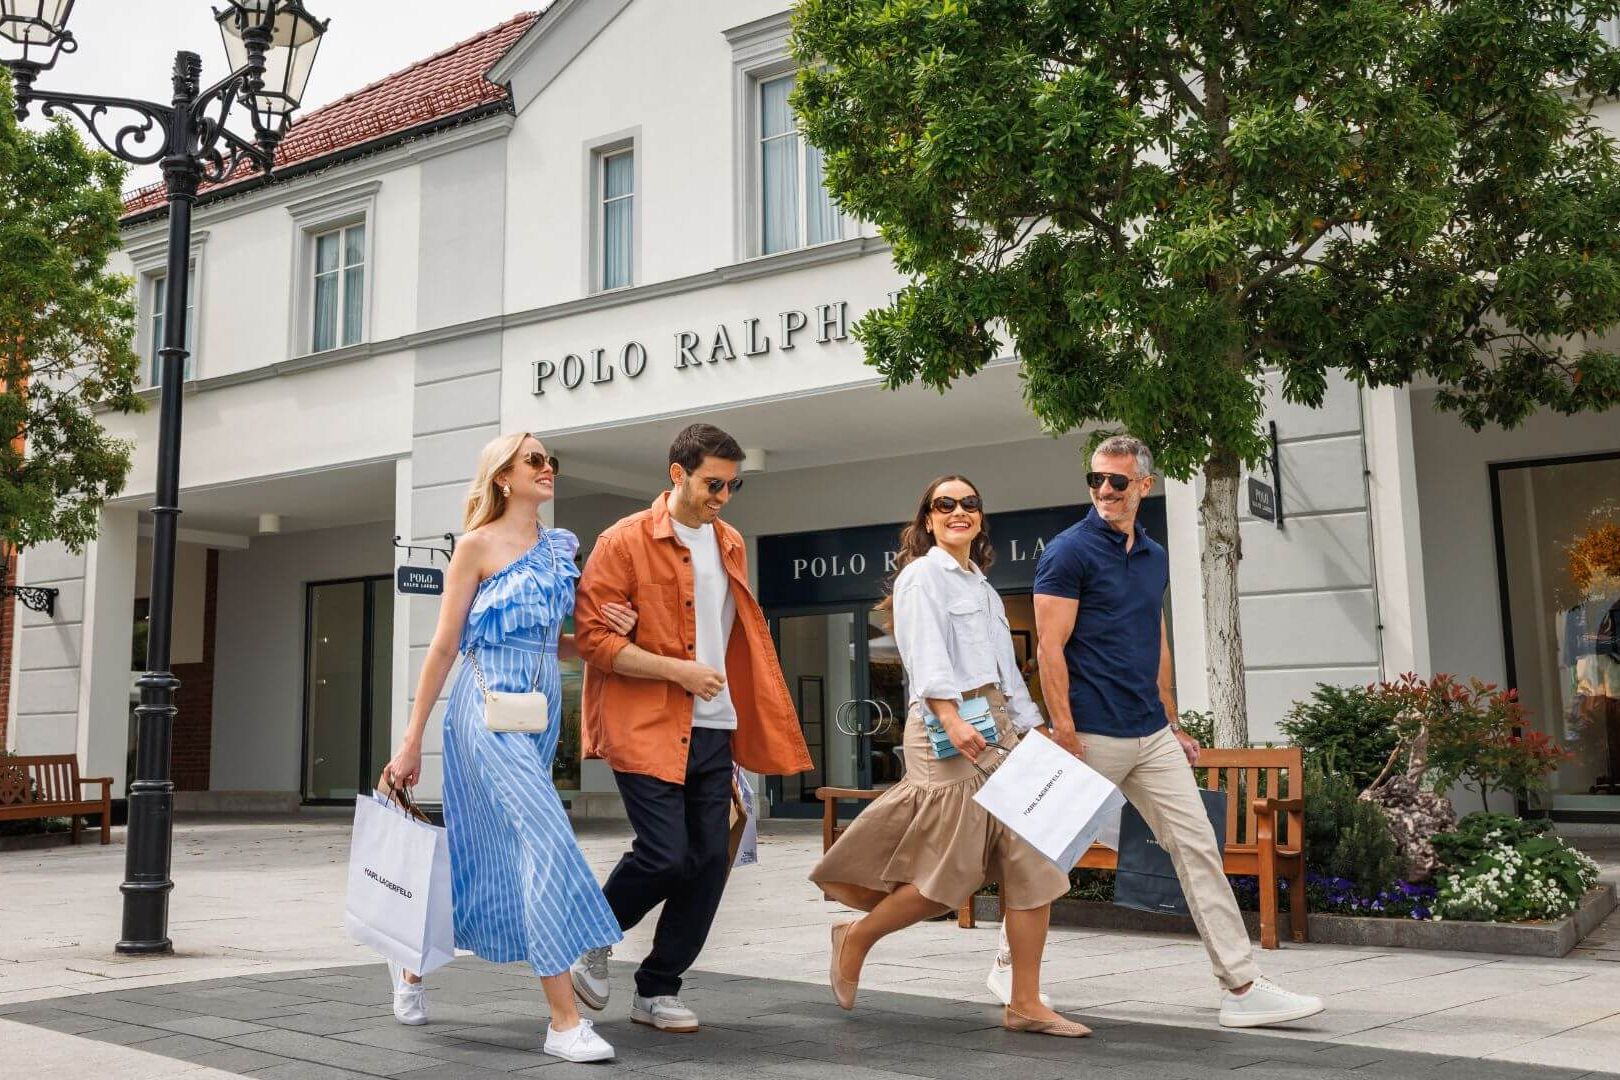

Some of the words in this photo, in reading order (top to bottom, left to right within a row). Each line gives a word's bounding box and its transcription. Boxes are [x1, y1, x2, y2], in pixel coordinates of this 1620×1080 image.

[531, 340, 647, 396] POLO
[673, 300, 849, 370] RALPH
[409, 572, 433, 584] POLO
[793, 553, 866, 580] POLO
[364, 867, 379, 881] KARL
[379, 875, 413, 899] LAGERFELD
